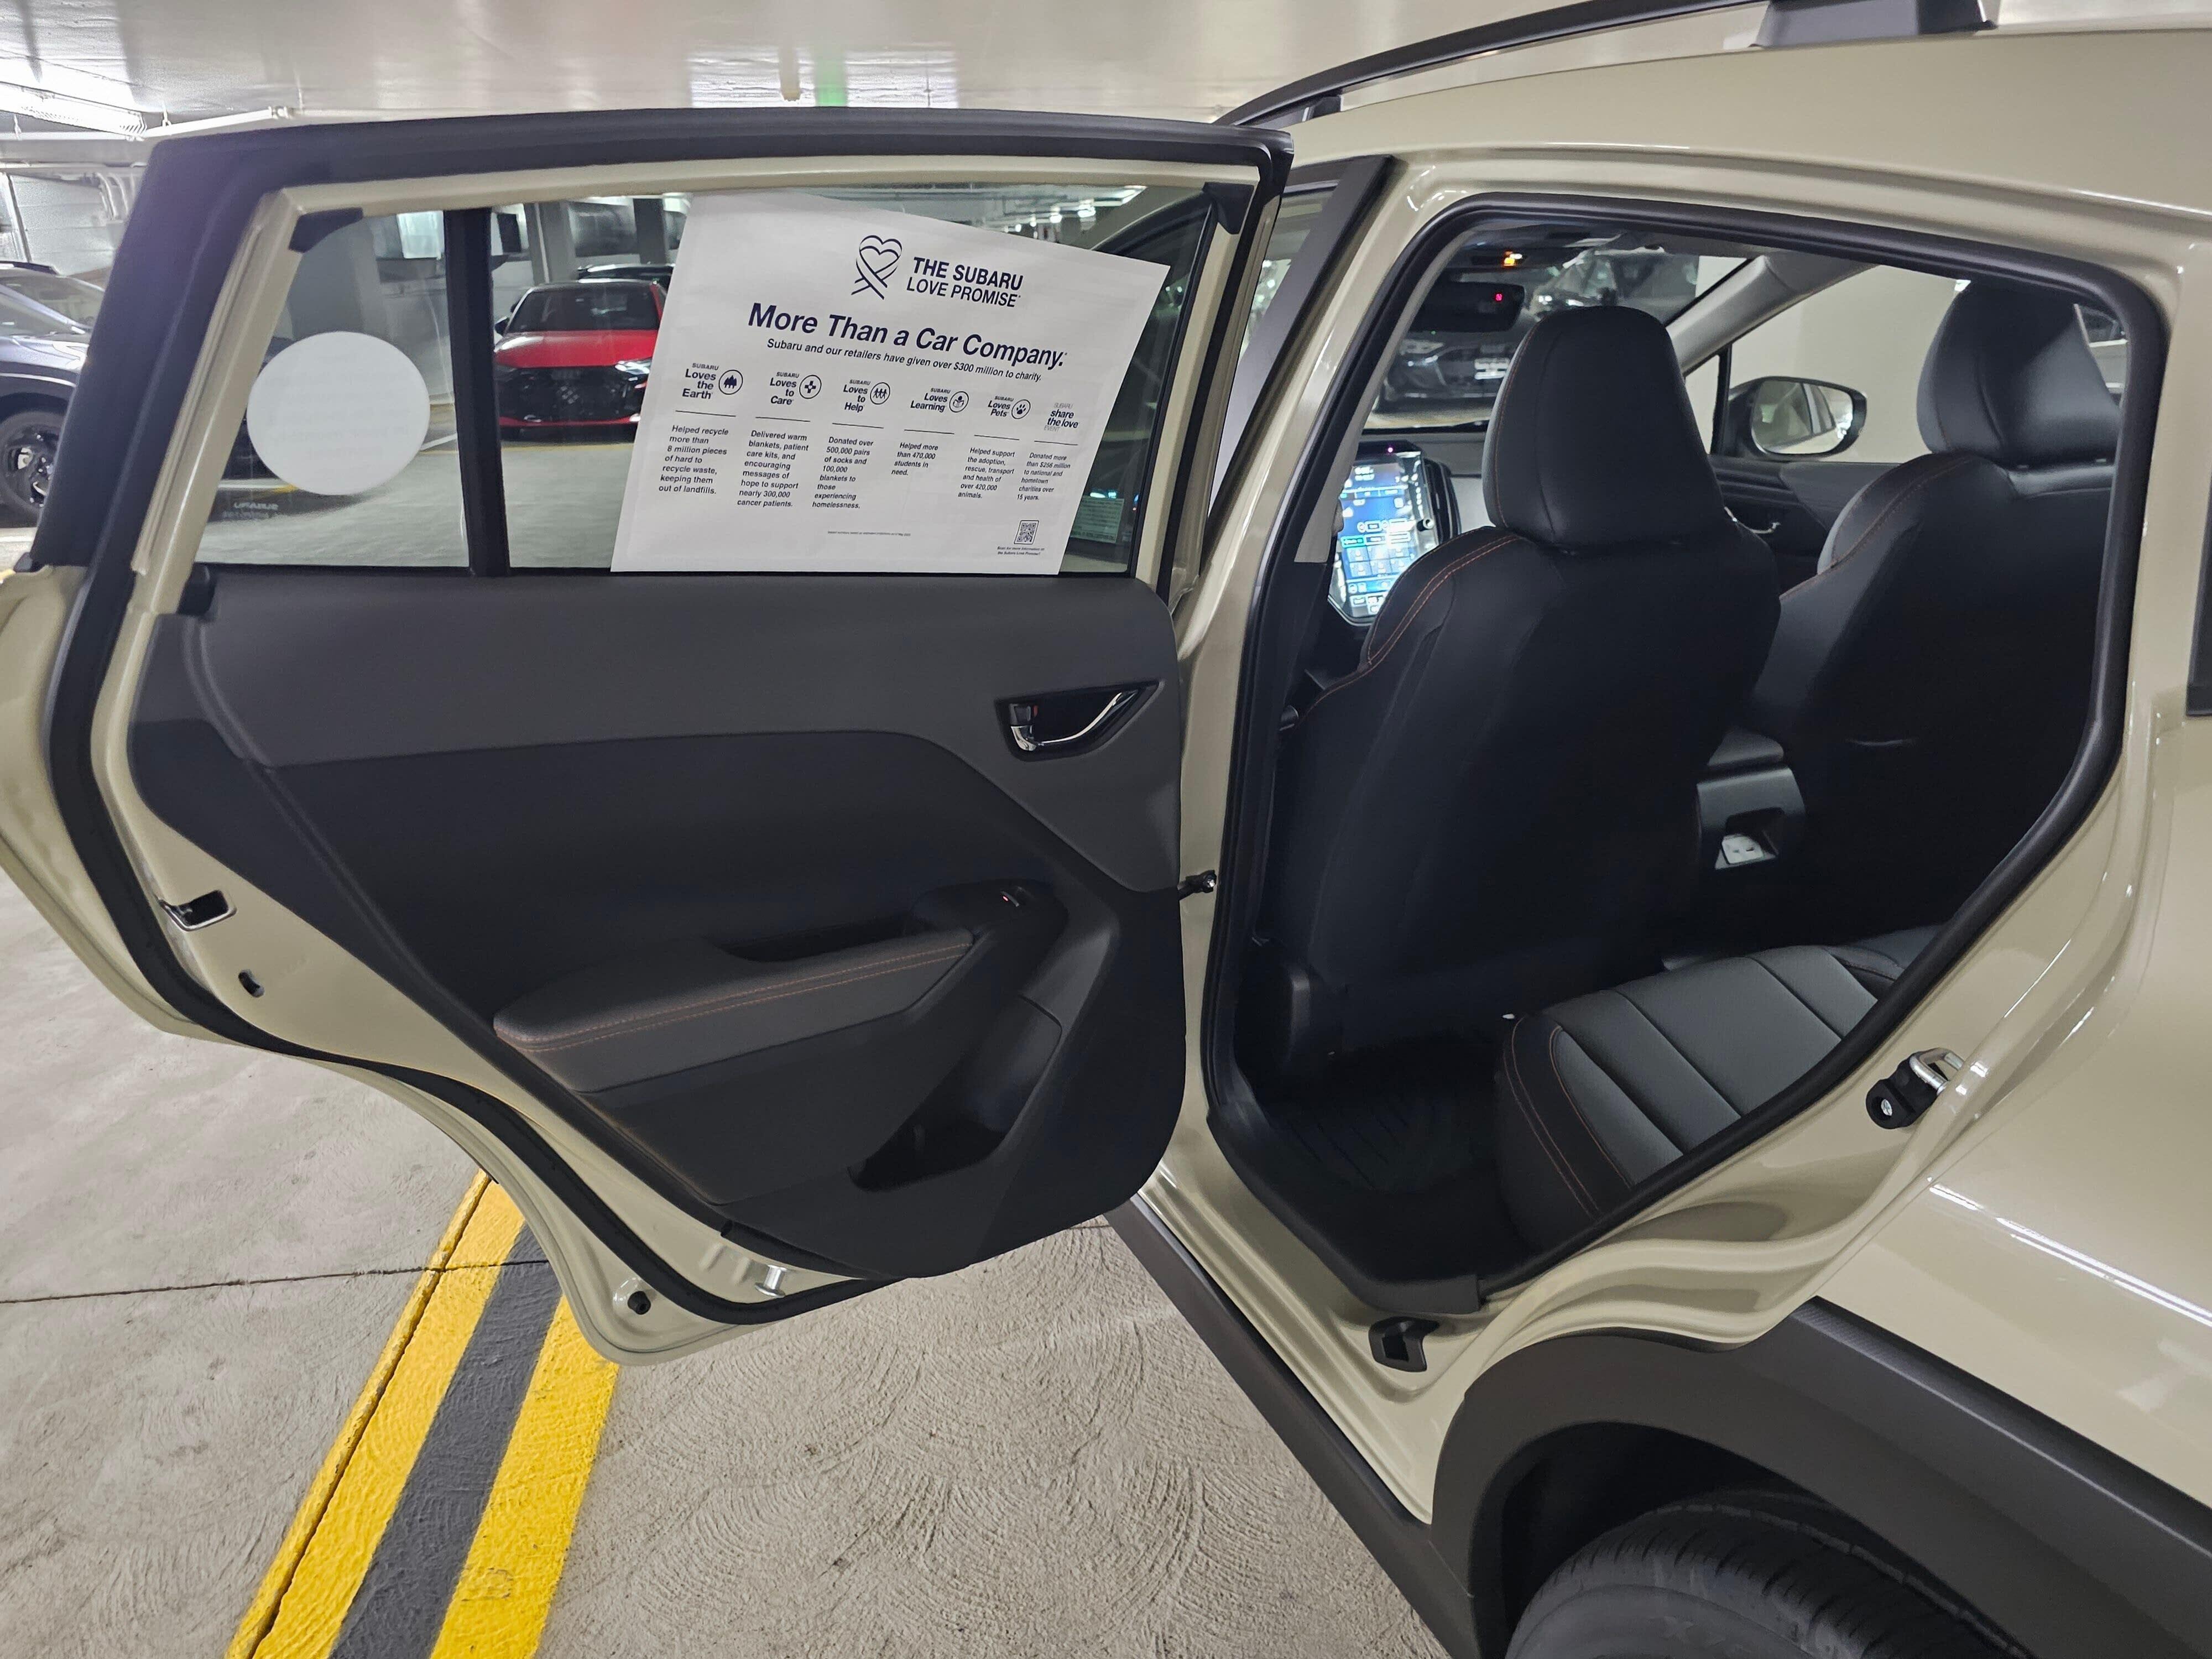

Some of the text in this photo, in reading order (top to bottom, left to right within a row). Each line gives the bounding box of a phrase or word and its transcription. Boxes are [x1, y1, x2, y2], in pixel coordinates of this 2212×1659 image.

[913, 257, 1023, 290] THE SUBARU
[906, 276, 1018, 307] LOVE PROMISE
[748, 302, 1063, 371] More Than a Car Company.
[767, 338, 802, 351] Subaru
[805, 344, 823, 353] and
[826, 347, 842, 356] our
[844, 349, 881, 360] retailers
[884, 353, 905, 363] have
[906, 356, 930, 366] given
[953, 362, 974, 372] $300
[975, 366, 1003, 377] million
[1005, 370, 1014, 378] to
[1015, 372, 1041, 381] charity.
[685, 369, 716, 380] Loves
[697, 381, 714, 390] the
[770, 377, 797, 388] Loves
[682, 388, 711, 399] Earth
[785, 389, 794, 397] to
[843, 385, 868, 395] Loves
[771, 395, 792, 405] Care
[924, 393, 948, 402] Loves
[844, 403, 863, 413] Help
[910, 400, 945, 413] Learning
[988, 400, 1010, 409] Loves
[990, 409, 1007, 417] Pets
[1051, 409, 1074, 419] share
[1047, 418, 1078, 428] the love
[672, 425, 700, 434] Helped
[751, 430, 785, 439] Delivered
[749, 440, 781, 449] blankets,
[828, 436, 857, 445] Donated
[826, 446, 852, 455] 500,000
[744, 461, 791, 471] encouraging
[660, 474, 691, 484] keeping
[741, 479, 759, 488] hope
[739, 490, 761, 498] nearly
